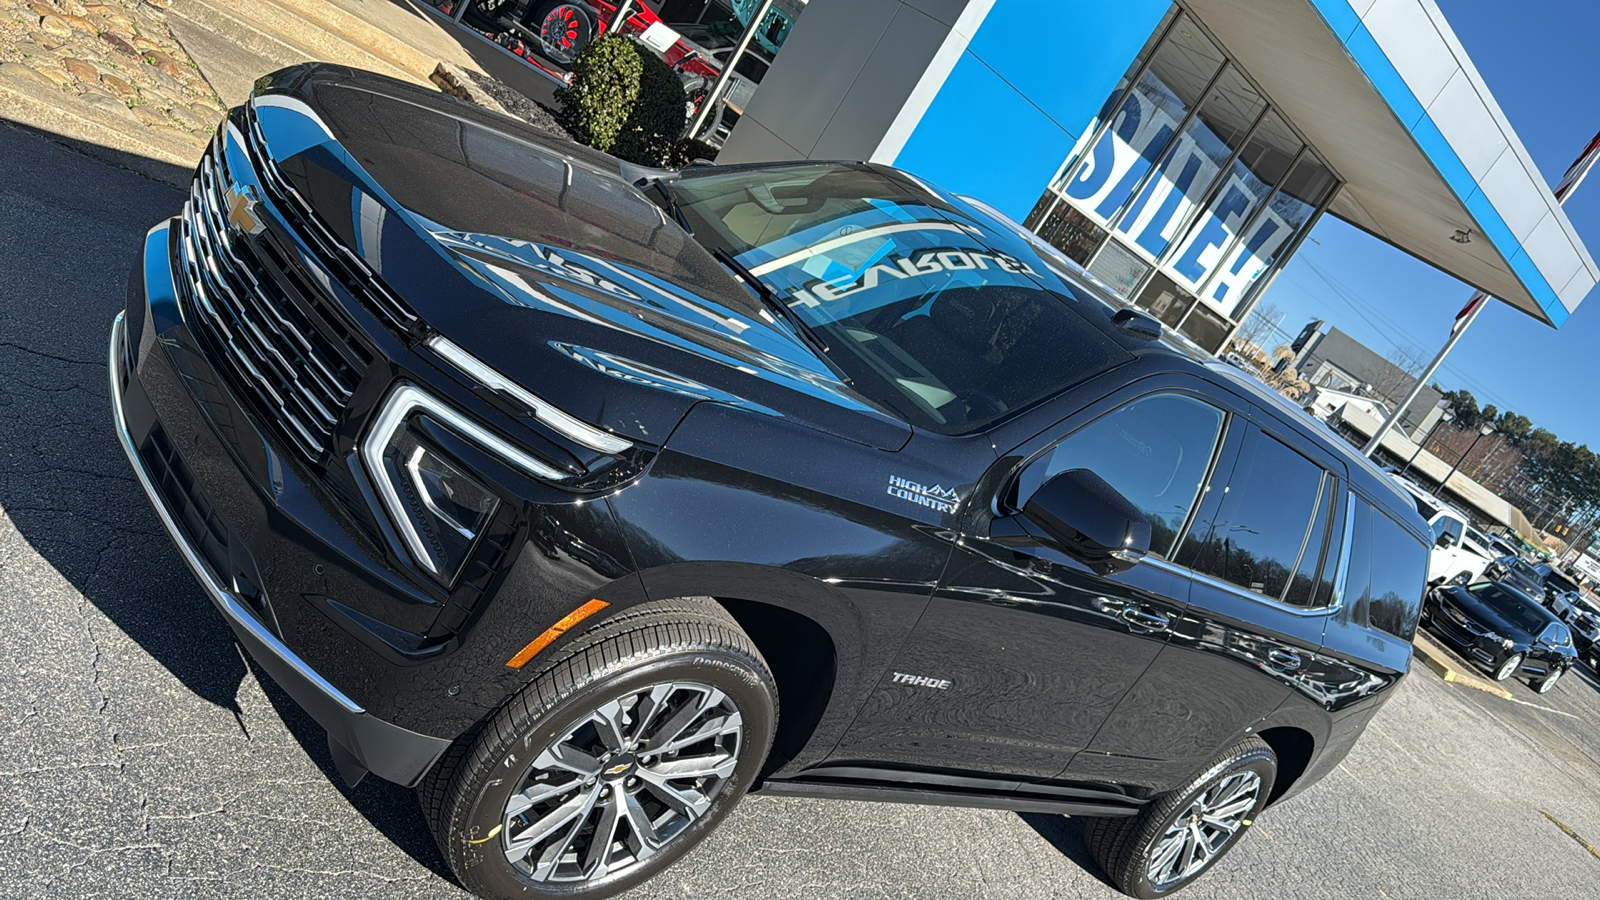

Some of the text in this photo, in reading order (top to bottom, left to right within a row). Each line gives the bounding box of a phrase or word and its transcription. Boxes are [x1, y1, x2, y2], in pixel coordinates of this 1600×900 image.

[1064, 88, 1280, 303] SALE!
[888, 474, 928, 495] HIGH
[886, 485, 960, 515] COUNTRY
[892, 671, 952, 690] TAHOE
